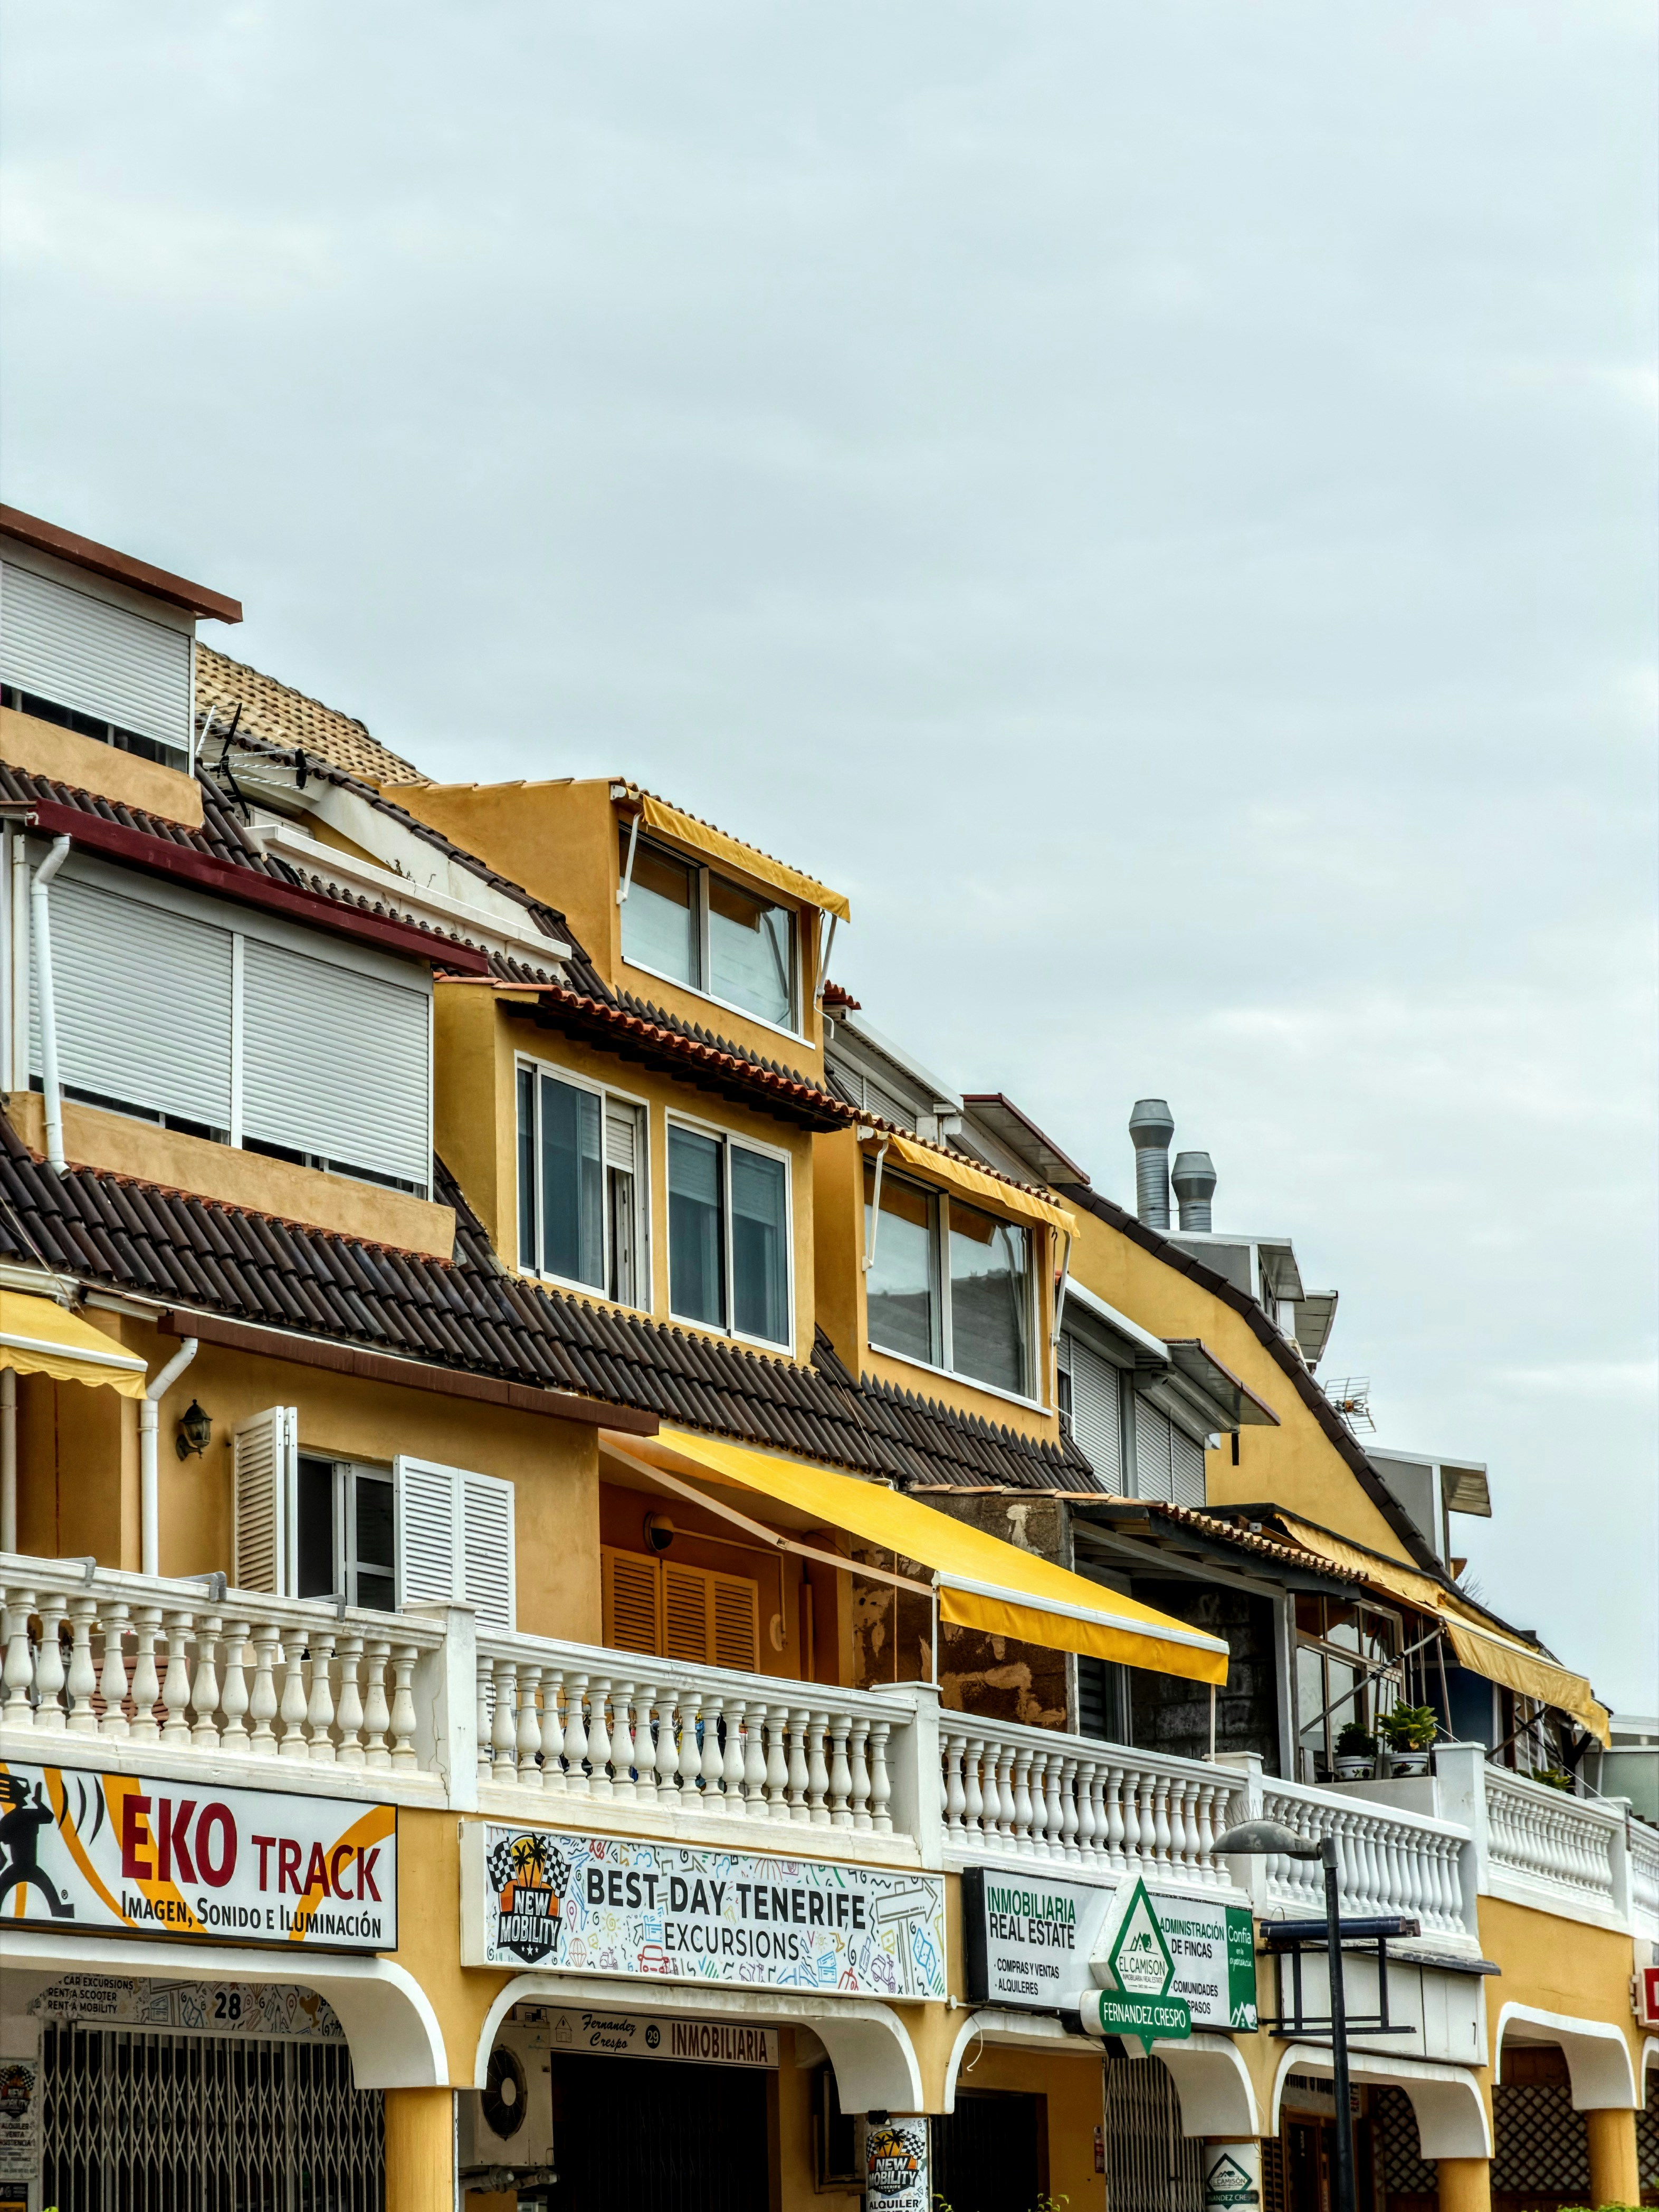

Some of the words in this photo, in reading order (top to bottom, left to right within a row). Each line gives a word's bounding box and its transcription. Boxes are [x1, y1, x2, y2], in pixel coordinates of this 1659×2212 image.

[122, 1794, 237, 1887] EKO
[251, 1834, 382, 1902] TRACK
[514, 1890, 550, 1916] NEW
[587, 1868, 659, 1910] BEST
[670, 1875, 727, 1916] DAY
[736, 1882, 866, 1930] TENERIFE
[987, 1886, 1076, 1924] INMOBILIARIA
[197, 1898, 261, 1929] SONIDO
[266, 1909, 274, 1930] E
[500, 1915, 559, 1947] MOBILITY
[989, 1912, 1025, 1942] REAL
[1028, 1918, 1075, 1950] ESTATE
[1160, 1917, 1225, 1941] ADMINISTRACIÓN
[1228, 1924, 1252, 1944] Confía
[664, 1922, 799, 1961] EXCURSIONS
[1171, 1938, 1183, 1954] DE
[1185, 1940, 1212, 1959] FINCAS
[997, 1958, 1029, 1975] COMPRAS
[1029, 1962, 1034, 1976] Y
[1035, 1963, 1060, 1979] VENTAS
[1119, 1956, 1129, 1972] EL
[1130, 1957, 1166, 1977] CAMISON
[83, 1977, 134, 1990] EXCURSIONS
[998, 1978, 1038, 1996] ALQUILERES
[1173, 1980, 1218, 1997] COMUNIDADES
[80, 1989, 117, 2001] SCOOTER
[214, 1991, 241, 2020] 28
[80, 2003, 118, 2014] MOBILITY
[1103, 2002, 1153, 2025] FERNANDEZ
[1154, 2007, 1186, 2028] CRESPO
[1187, 1999, 1211, 2015] SPASOS
[581, 2014, 636, 2037] Fernandez
[589, 2032, 628, 2052] Crespo
[647, 2029, 659, 2044] 29
[671, 2023, 768, 2063] INMOBILIARIA
[876, 2158, 908, 2170] NEW
[869, 2171, 916, 2186] MOBILITY
[869, 2199, 919, 2210] ALQUILER
